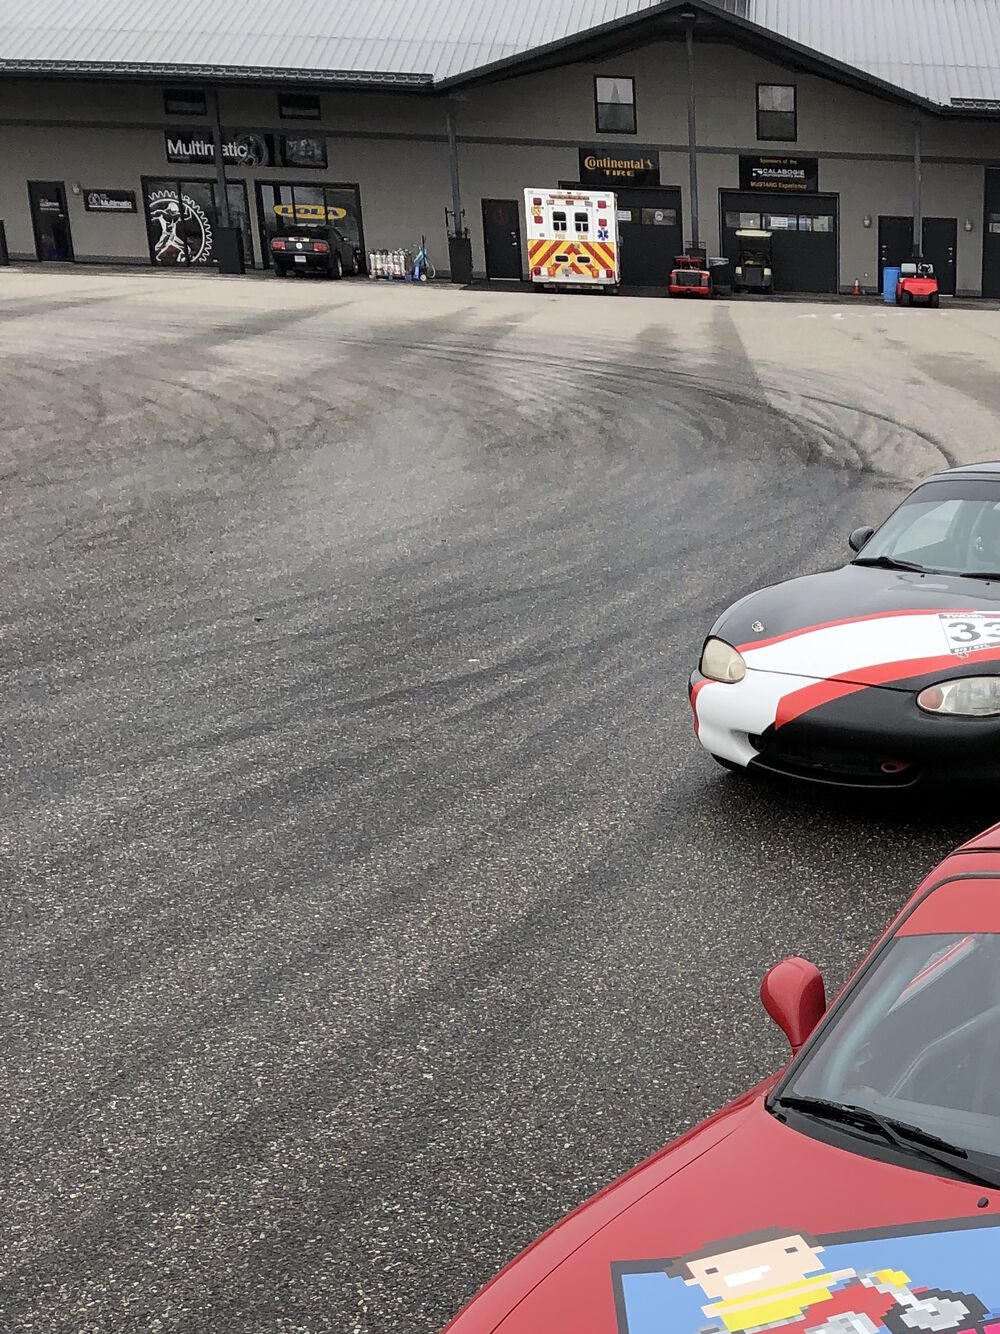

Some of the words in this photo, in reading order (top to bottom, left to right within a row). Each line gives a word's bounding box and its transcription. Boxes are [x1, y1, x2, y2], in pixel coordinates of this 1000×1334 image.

[167, 139, 248, 157] Multimatic
[584, 156, 644, 170] Continental
[605, 169, 635, 177] TIRE
